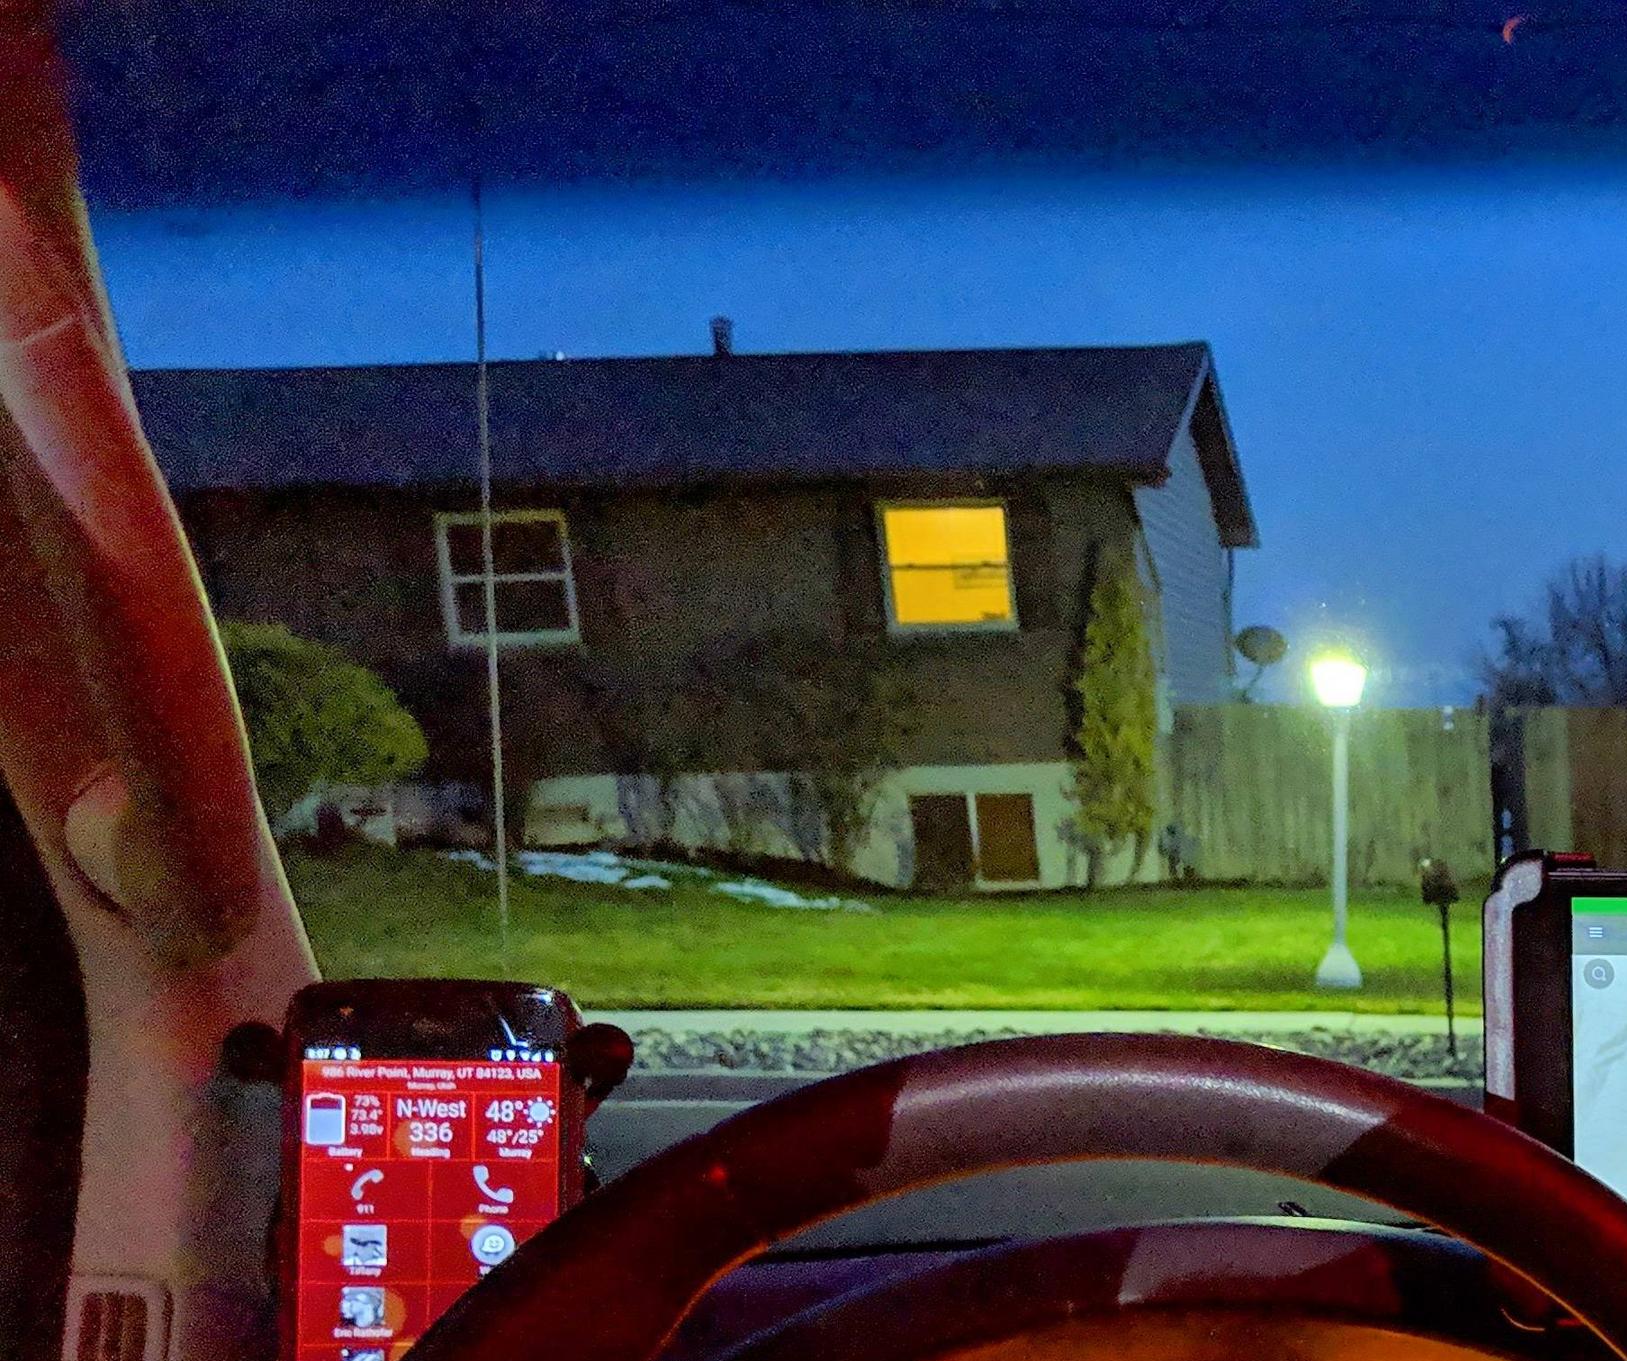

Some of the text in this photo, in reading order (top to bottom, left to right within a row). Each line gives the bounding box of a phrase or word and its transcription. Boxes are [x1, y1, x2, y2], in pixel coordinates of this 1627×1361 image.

[516, 1067, 542, 1079] USA
[395, 1098, 467, 1118] N-West
[408, 1121, 454, 1142] 336
